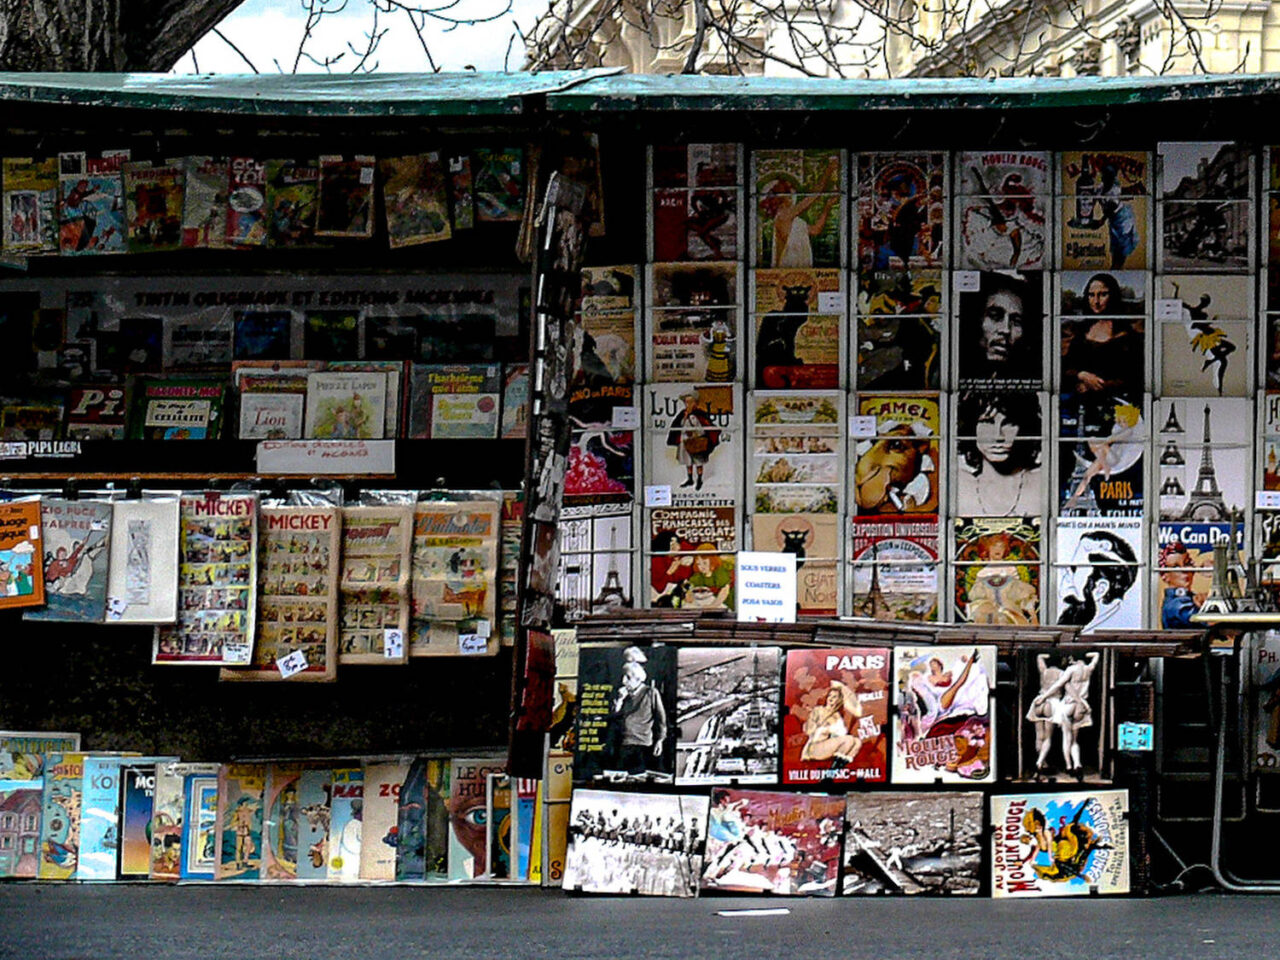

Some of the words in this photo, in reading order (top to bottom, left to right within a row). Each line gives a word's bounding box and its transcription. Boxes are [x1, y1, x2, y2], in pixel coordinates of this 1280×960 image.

[982, 153, 1017, 168] MOULIN
[135, 291, 189, 306] TINTIN
[318, 290, 399, 306] EDITIONS
[601, 386, 632, 399] PARIS
[651, 390, 678, 418] LU
[866, 401, 931, 420] CAMEL
[255, 412, 287, 426] Lion
[1100, 480, 1135, 500] PARIS
[195, 499, 252, 516] MICKEY
[269, 515, 332, 530] MICKEY
[1118, 521, 1141, 529] MIND
[1159, 526, 1178, 544] We
[1180, 526, 1207, 545] Can
[745, 581, 781, 589] COASTERS
[826, 654, 886, 671] PARIS
[456, 766, 477, 780] LE
[788, 768, 809, 781] VILLE
[810, 769, 820, 781] DU
[1006, 800, 1027, 841] ROUGE
[995, 825, 1005, 871] JOYEUX
[1004, 843, 1040, 893] MOULIN
[1086, 848, 1111, 883] PARIS
[995, 875, 1005, 890] AU
